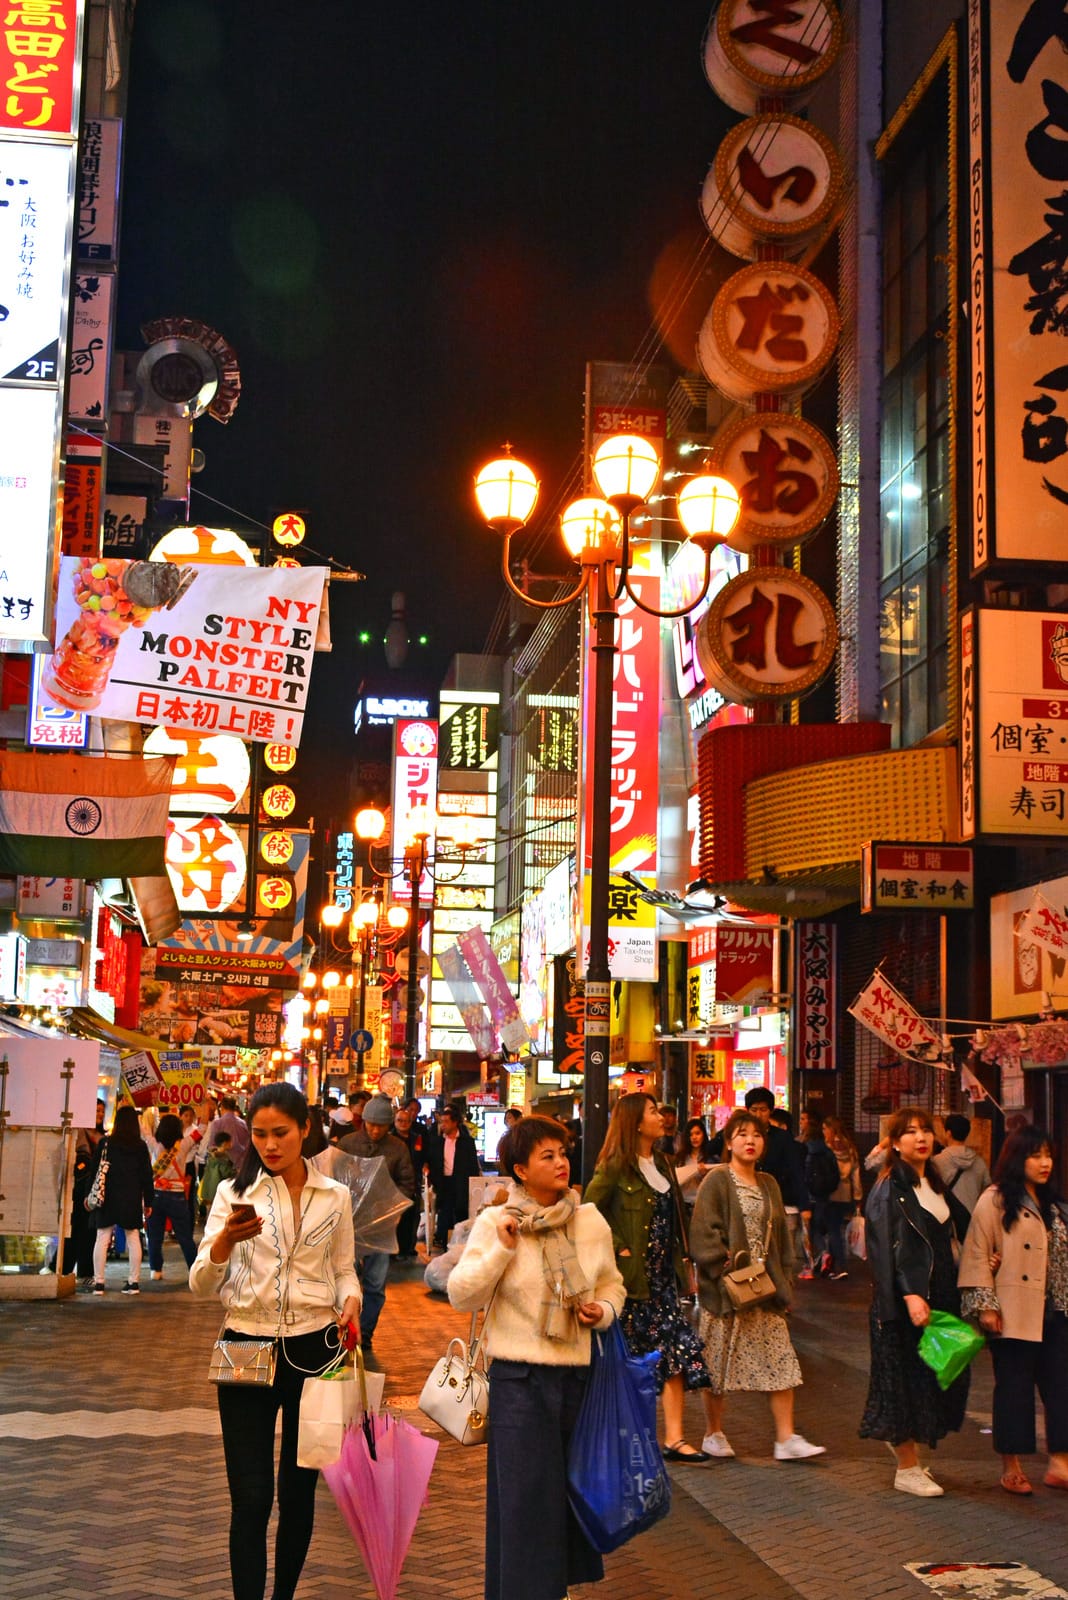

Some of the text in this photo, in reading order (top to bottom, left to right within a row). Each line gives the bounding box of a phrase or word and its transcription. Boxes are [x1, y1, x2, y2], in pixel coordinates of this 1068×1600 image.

[26, 360, 54, 378] 2F
[279, 515, 301, 540] 大
[266, 596, 318, 626] NY
[203, 614, 313, 652] STYLE
[139, 630, 308, 679] MONSTER
[157, 660, 305, 704] PALFEIT
[135, 692, 295, 740] 日本初上陸！
[33, 723, 83, 745] 免税
[1010, 786, 1066, 820] 寿司
[902, 851, 942, 869] 地階
[607, 883, 638, 921] 薬
[878, 878, 969, 901] 個室・和食
[718, 930, 772, 949] ツルハ
[718, 951, 759, 965] ドラッグ
[804, 932, 829, 1062] 大阪みやげ
[220, 1053, 236, 1063] 2F
[695, 1053, 715, 1079] 薬
[126, 1070, 151, 1087] EX
[159, 1083, 204, 1106] 4800
